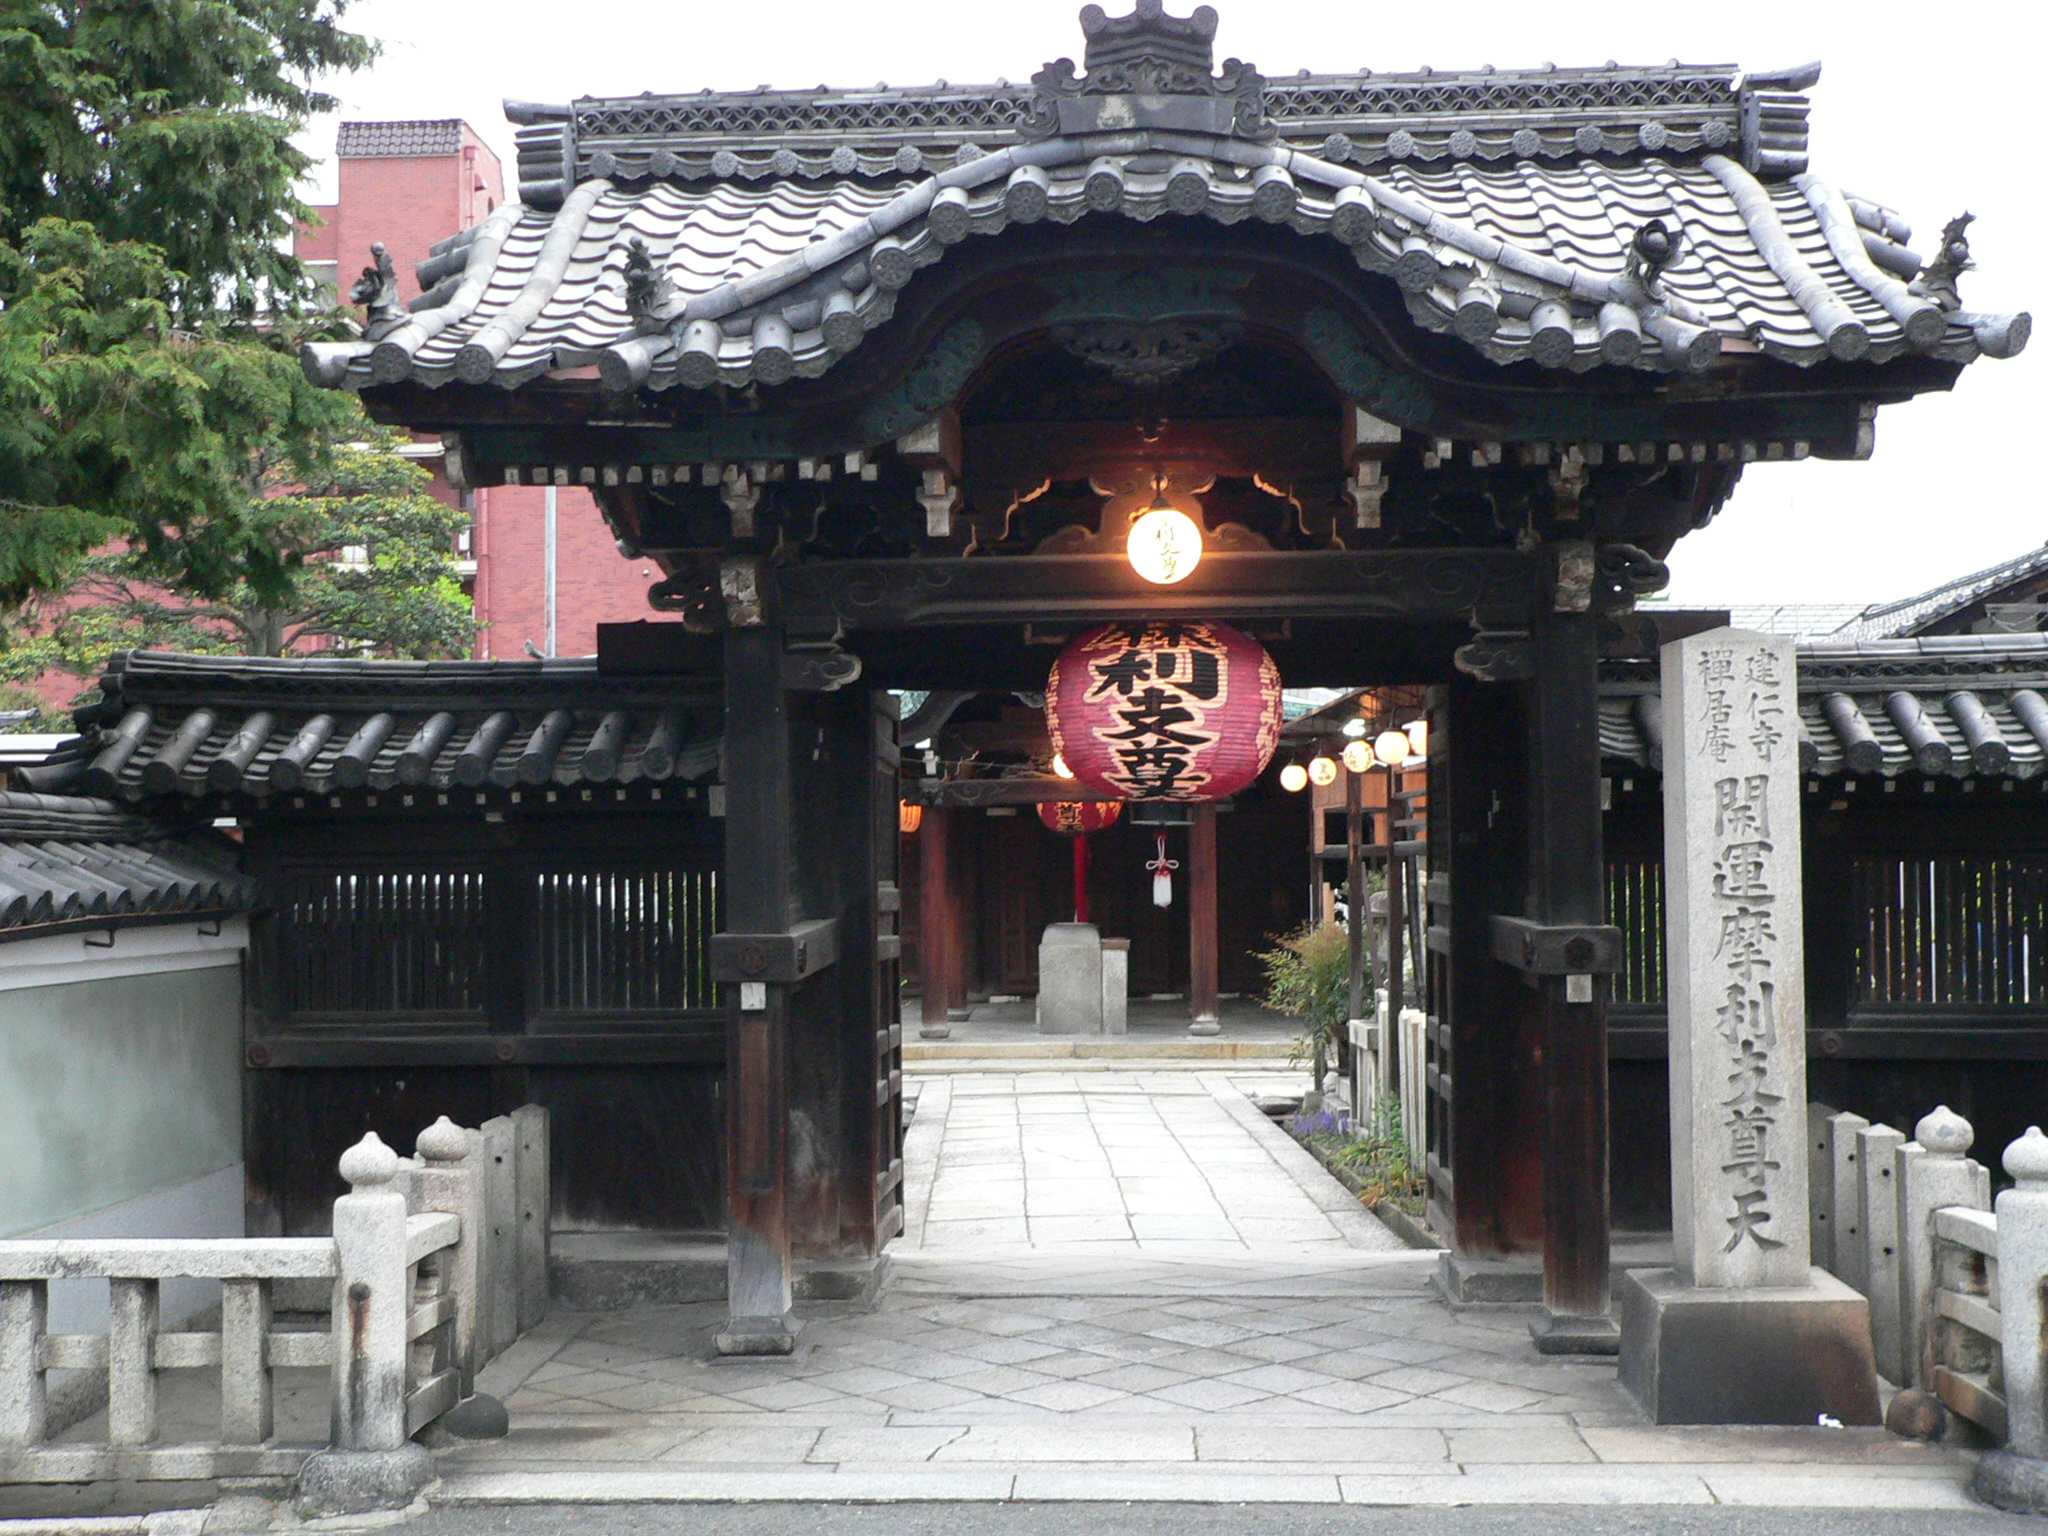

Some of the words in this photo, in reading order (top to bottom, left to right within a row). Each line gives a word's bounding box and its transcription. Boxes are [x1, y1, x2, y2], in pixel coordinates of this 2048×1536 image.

[1743, 647, 1783, 762] 建仁寺
[1711, 773, 1786, 1254] 開運摩利支尊天
